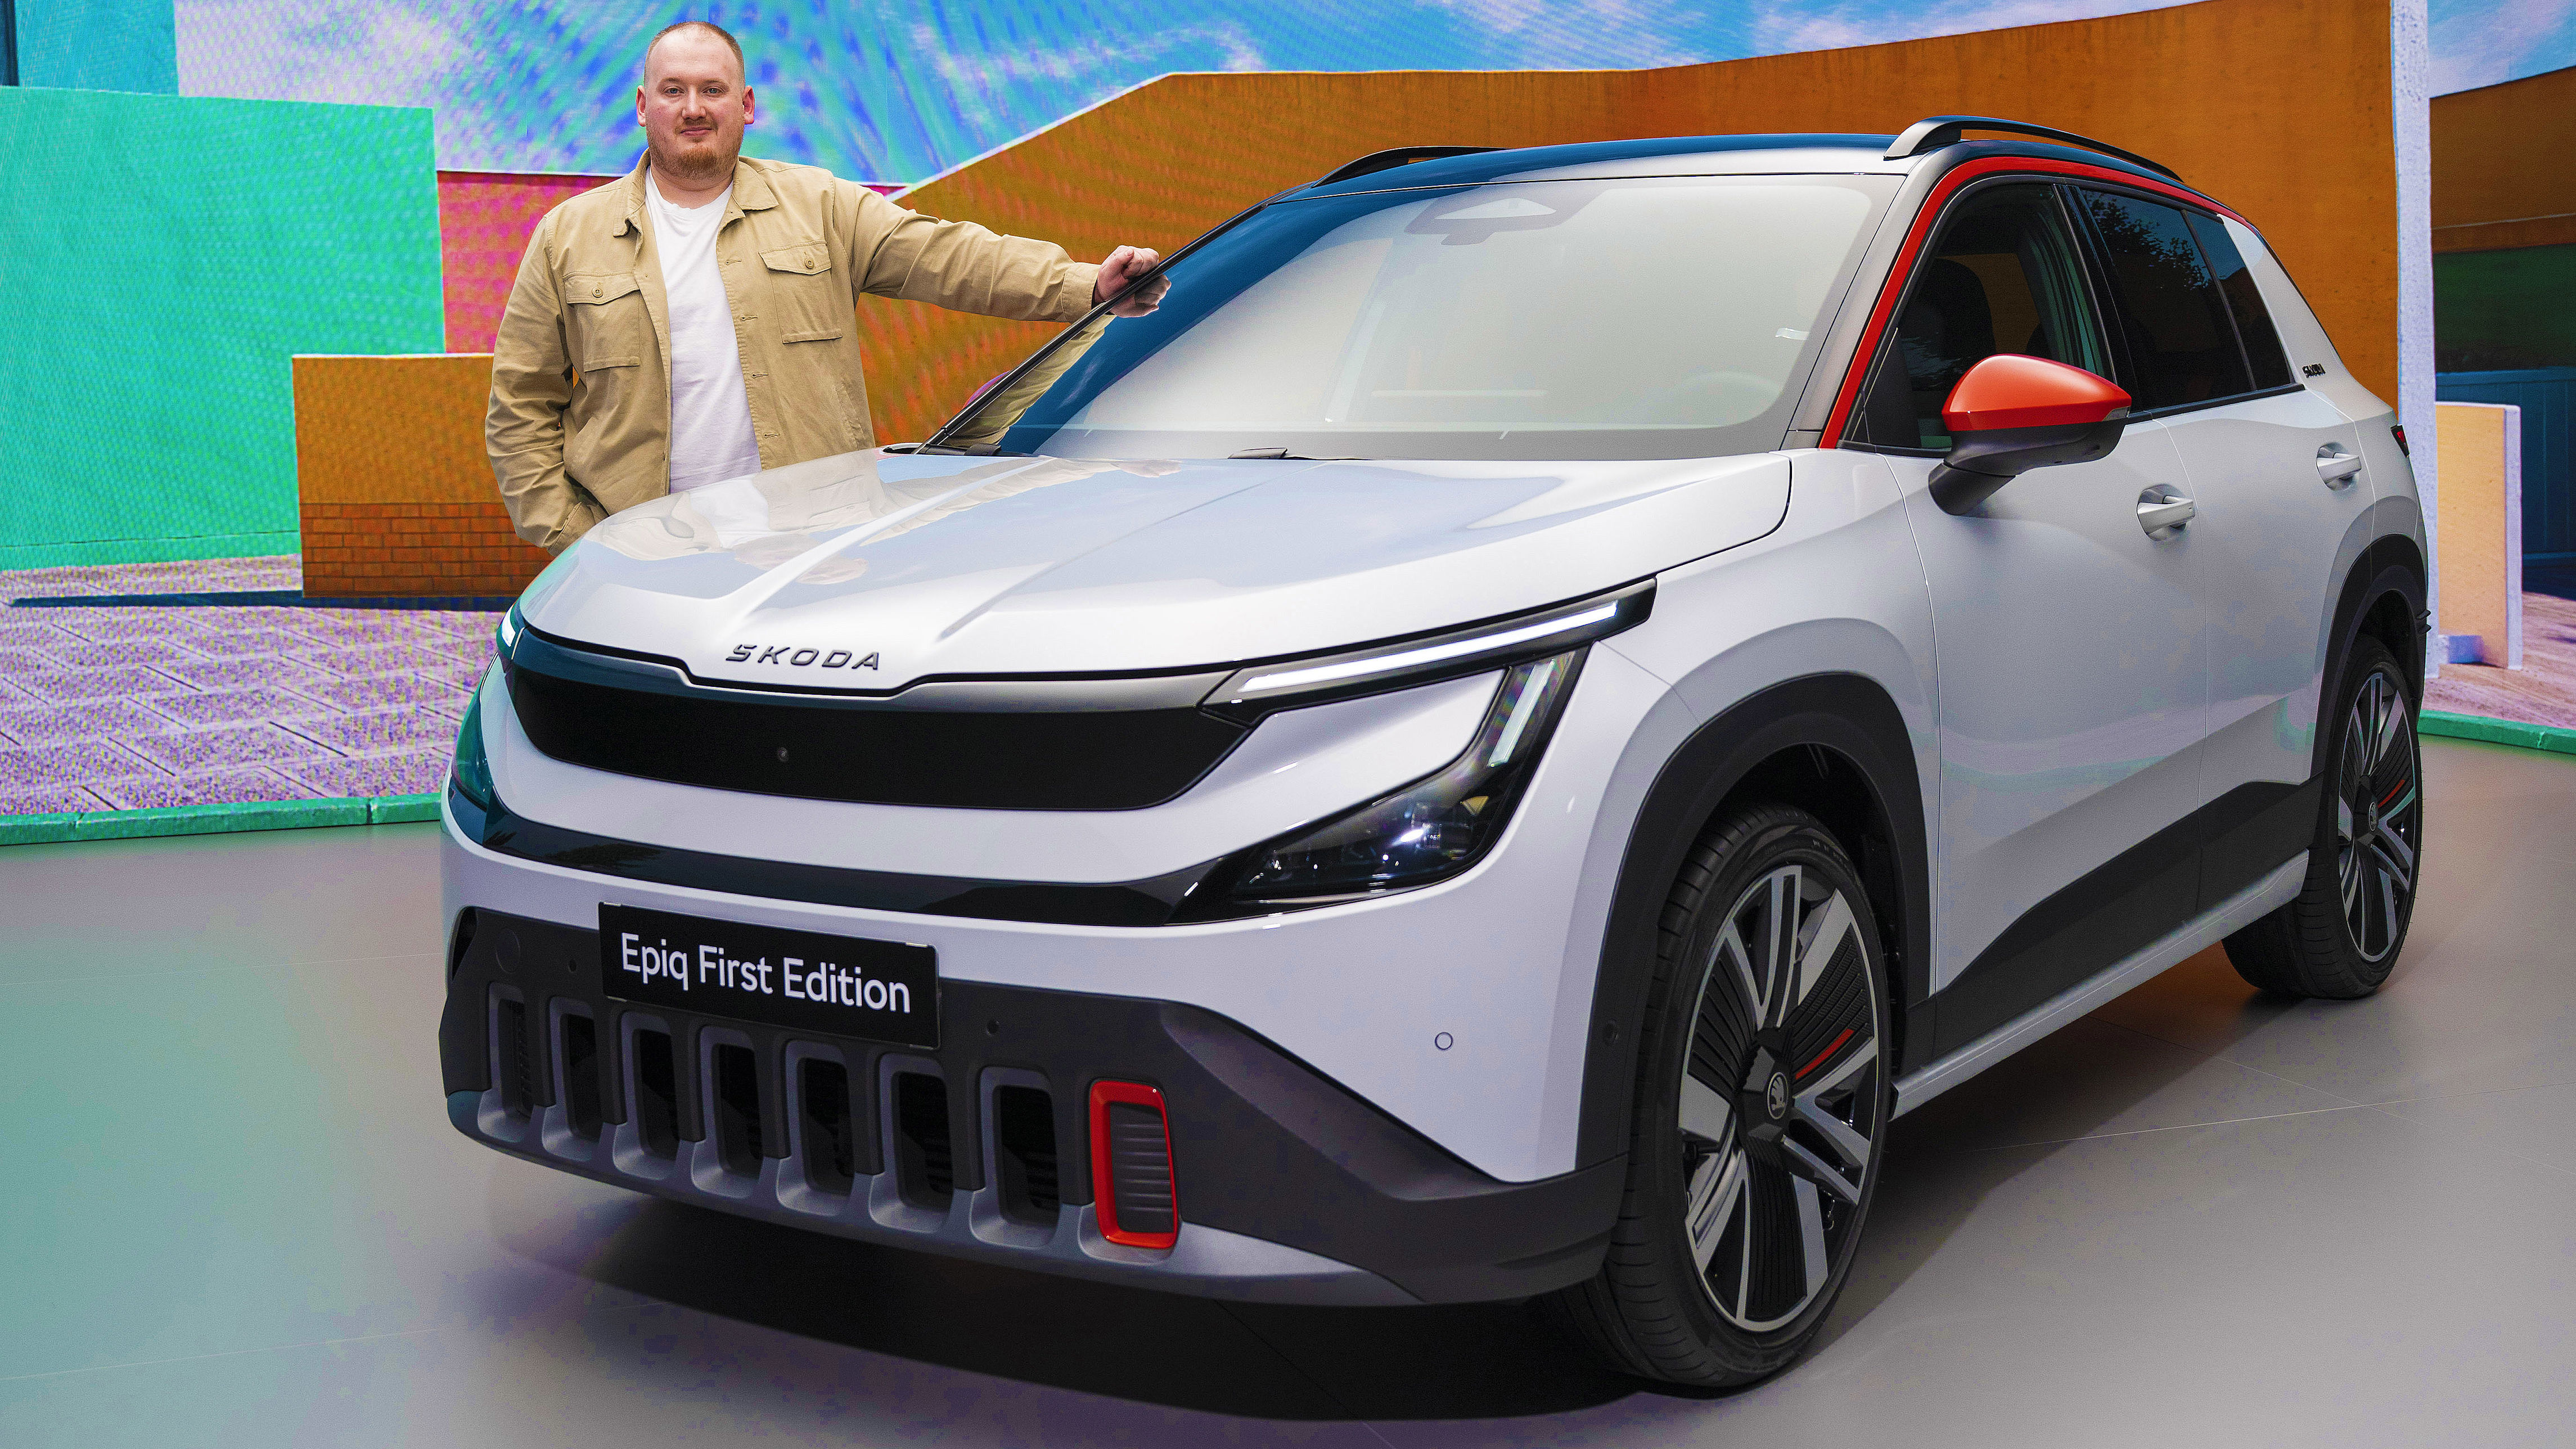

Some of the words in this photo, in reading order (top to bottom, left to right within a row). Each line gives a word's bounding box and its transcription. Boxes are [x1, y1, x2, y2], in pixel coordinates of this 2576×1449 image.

[622, 932, 688, 991] Epiq
[699, 944, 773, 994] First
[783, 957, 911, 1014] Edition
